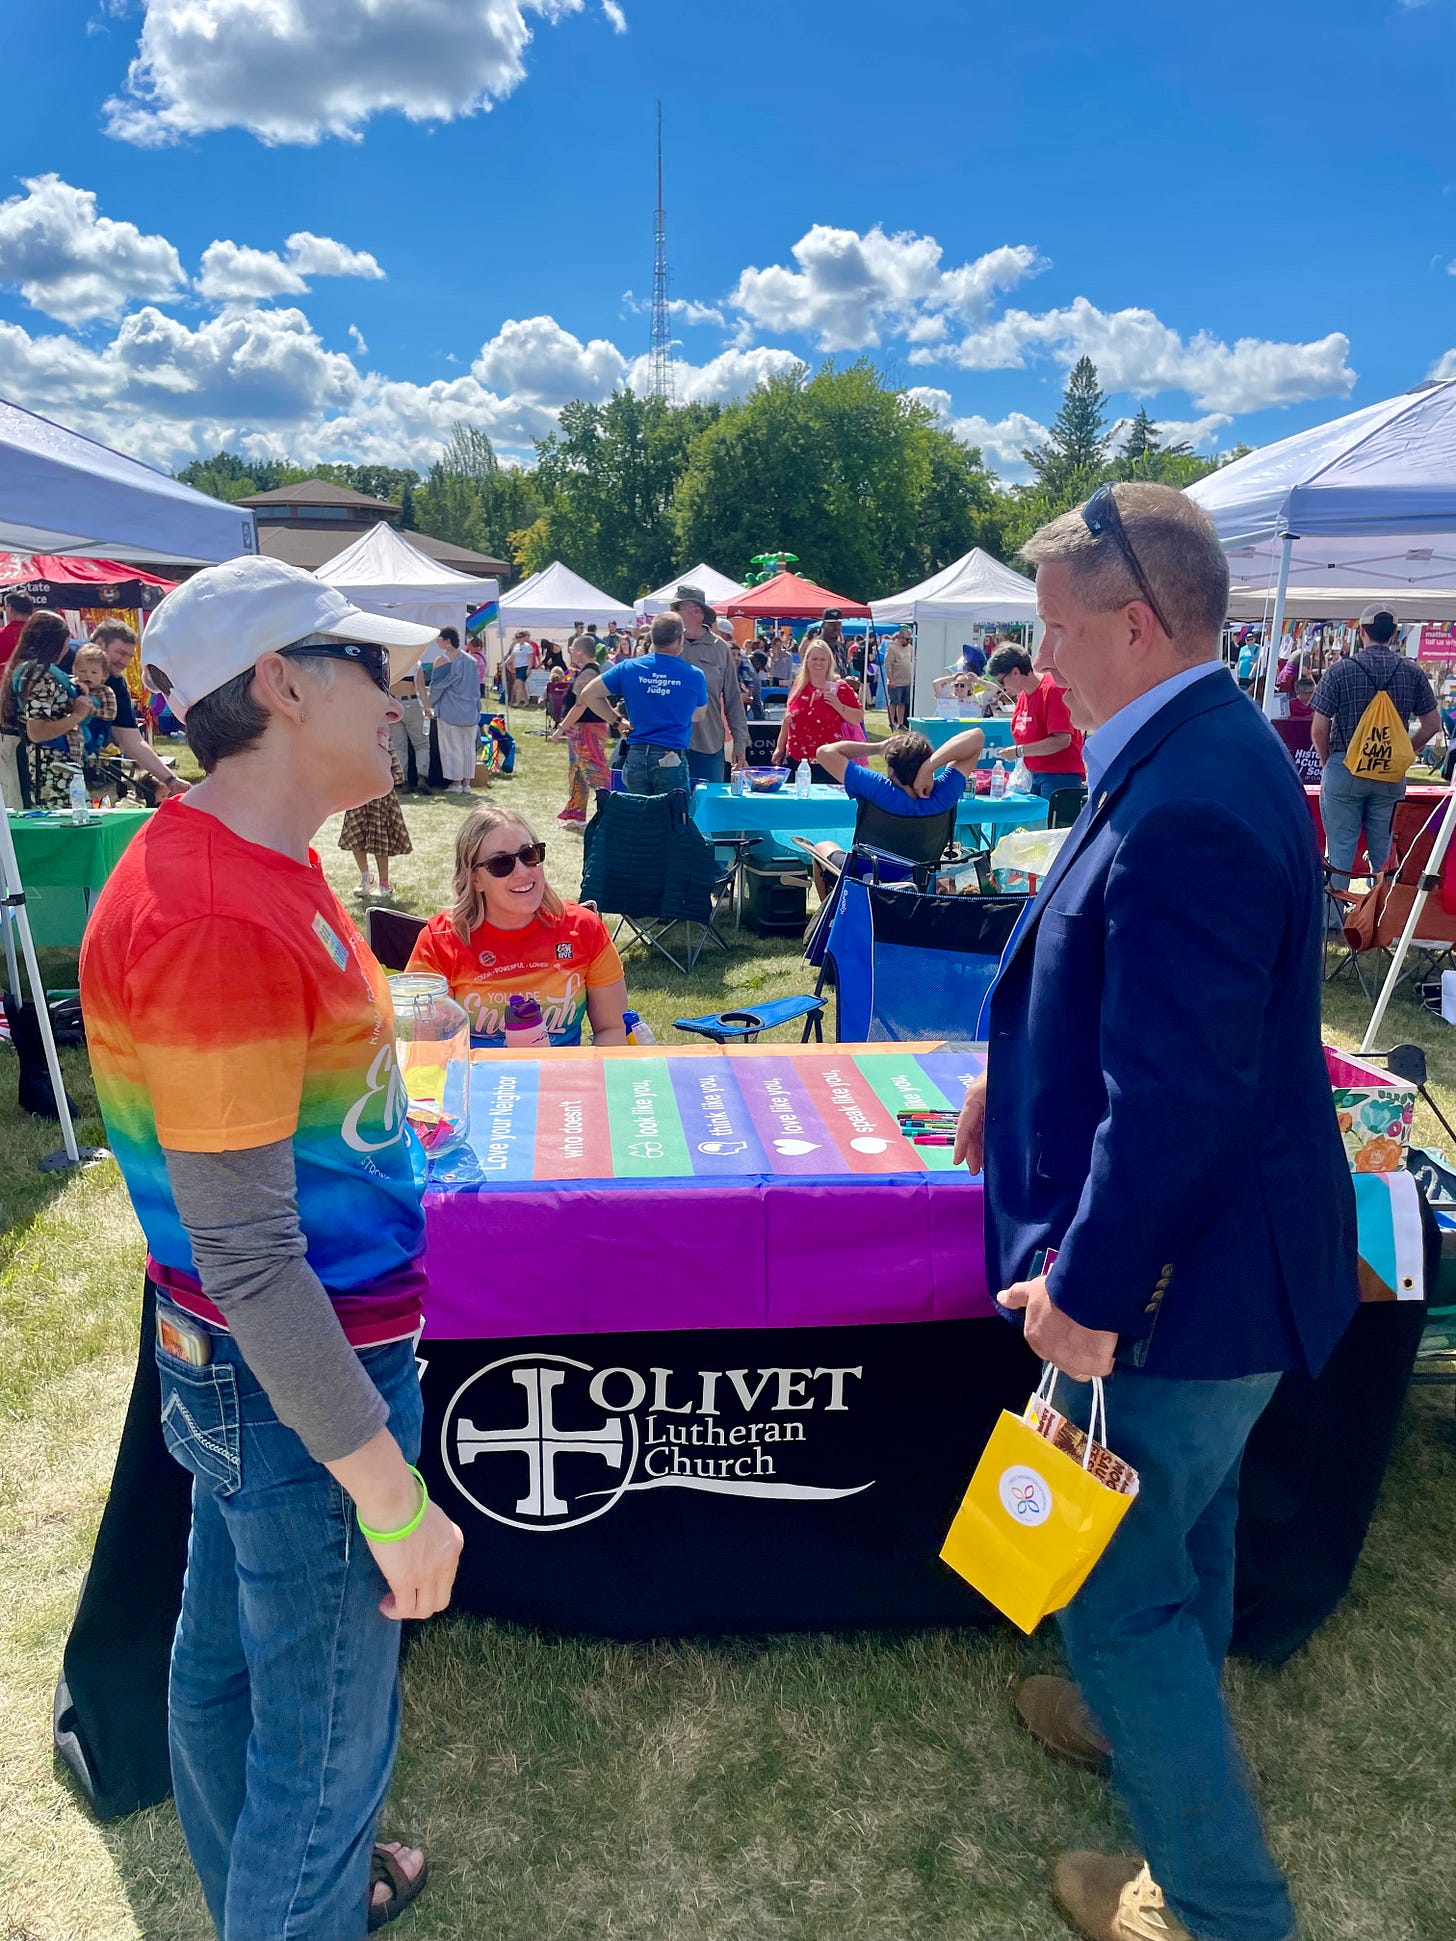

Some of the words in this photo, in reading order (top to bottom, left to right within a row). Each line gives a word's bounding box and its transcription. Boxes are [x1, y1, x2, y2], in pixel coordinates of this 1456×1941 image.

[639, 676, 682, 687] Younggren
[646, 686, 671, 696] Judge
[1355, 757, 1392, 773] LIFE
[698, 1075, 725, 1094] you,
[763, 1078, 791, 1095] you,
[822, 1069, 850, 1088] you,
[890, 1075, 921, 1093] you,
[489, 1076, 521, 1116] Neighbor
[632, 1079, 657, 1098] you,
[830, 1088, 855, 1105] like
[632, 1098, 655, 1115] like
[700, 1094, 725, 1110] like
[769, 1097, 794, 1113] like
[903, 1093, 929, 1109] like
[559, 1100, 583, 1134] doesn't
[704, 1111, 733, 1136] think
[779, 1114, 804, 1134] love
[837, 1105, 877, 1133] speak
[491, 1118, 517, 1140] your
[635, 1117, 659, 1138] look
[480, 1142, 509, 1171] Love
[559, 1136, 583, 1159] who
[589, 1366, 863, 1415] OLIVET
[645, 1415, 807, 1447] Lutheran
[644, 1446, 777, 1478] Church
